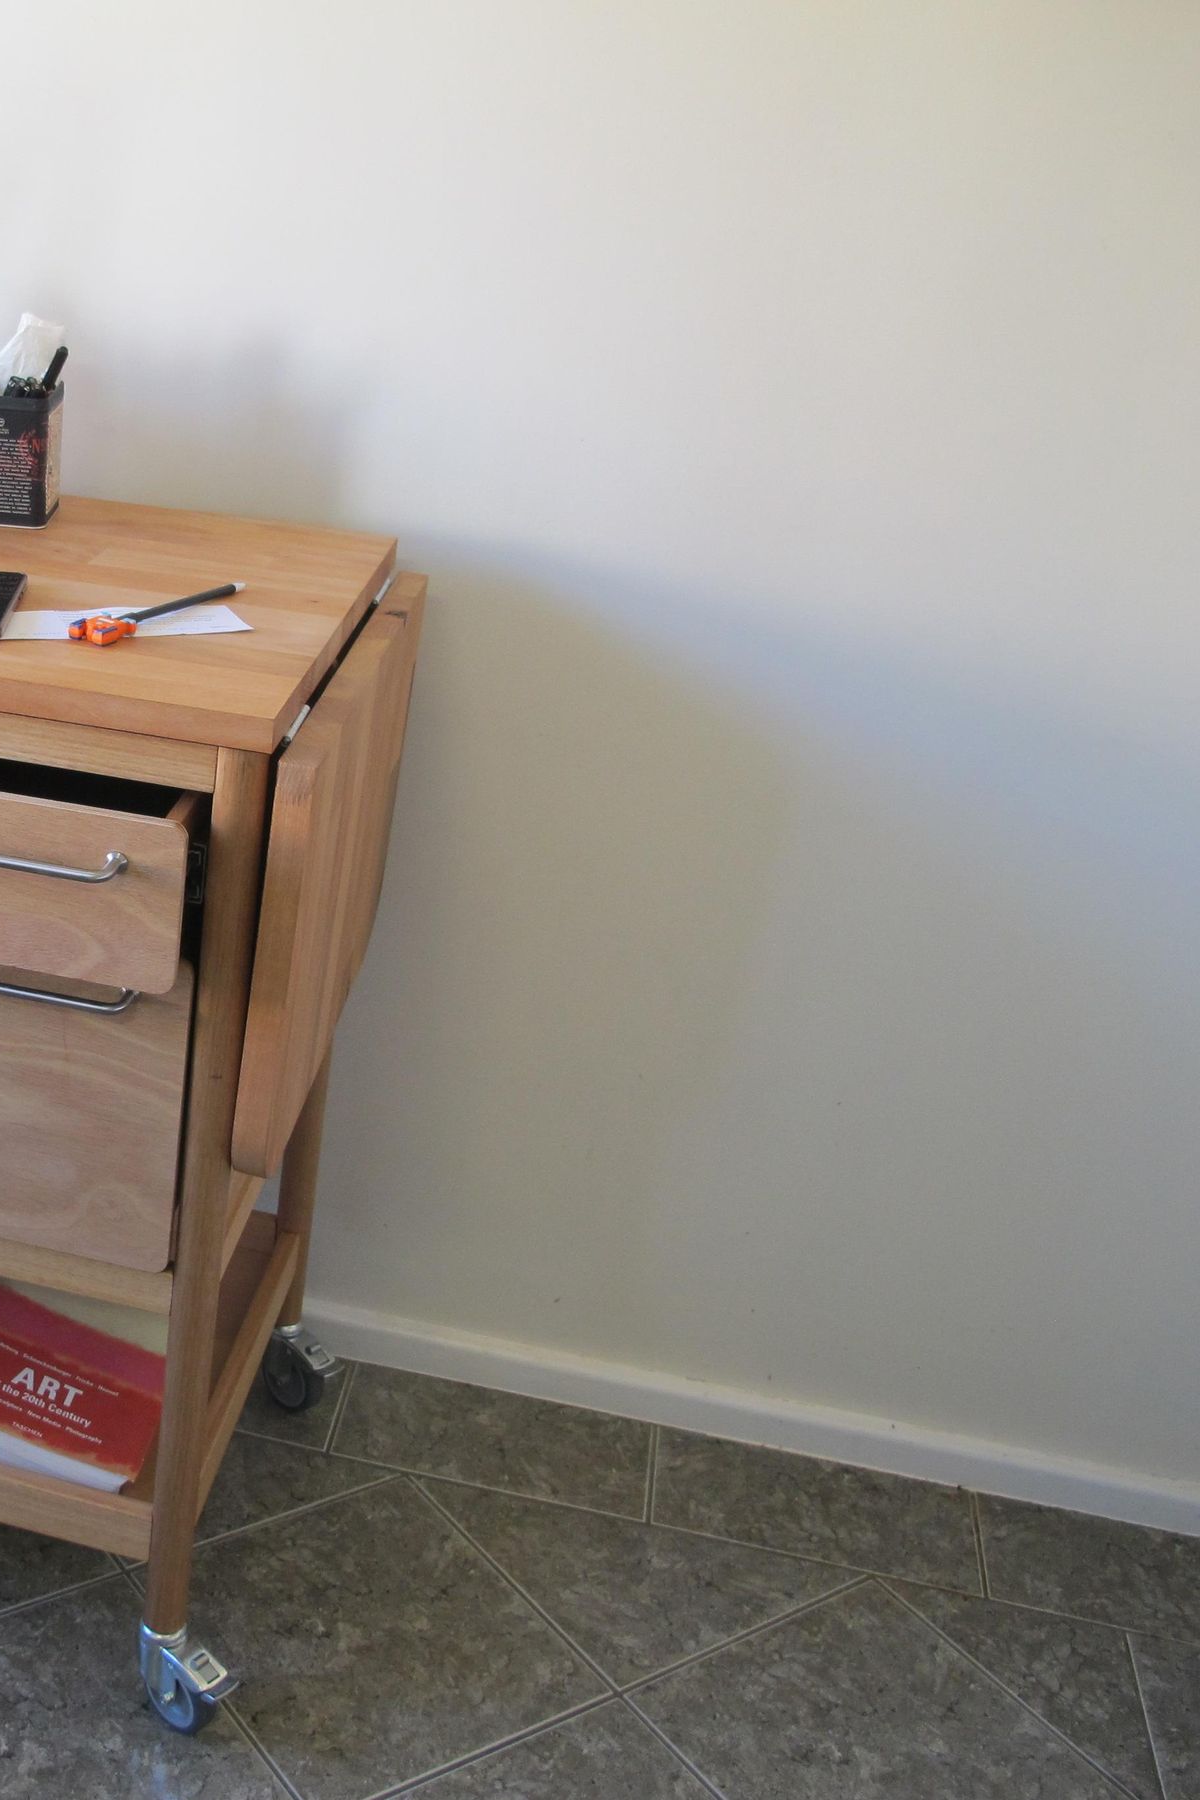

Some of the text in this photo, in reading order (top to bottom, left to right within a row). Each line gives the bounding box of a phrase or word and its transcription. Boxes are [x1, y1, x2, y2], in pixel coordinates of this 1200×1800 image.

[1, 1383, 20, 1397] the
[21, 1391, 46, 1408] 20th
[48, 1401, 92, 1428] Century
[11, 1366, 84, 1408] ART
[11, 1421, 44, 1438] TASCHEN
